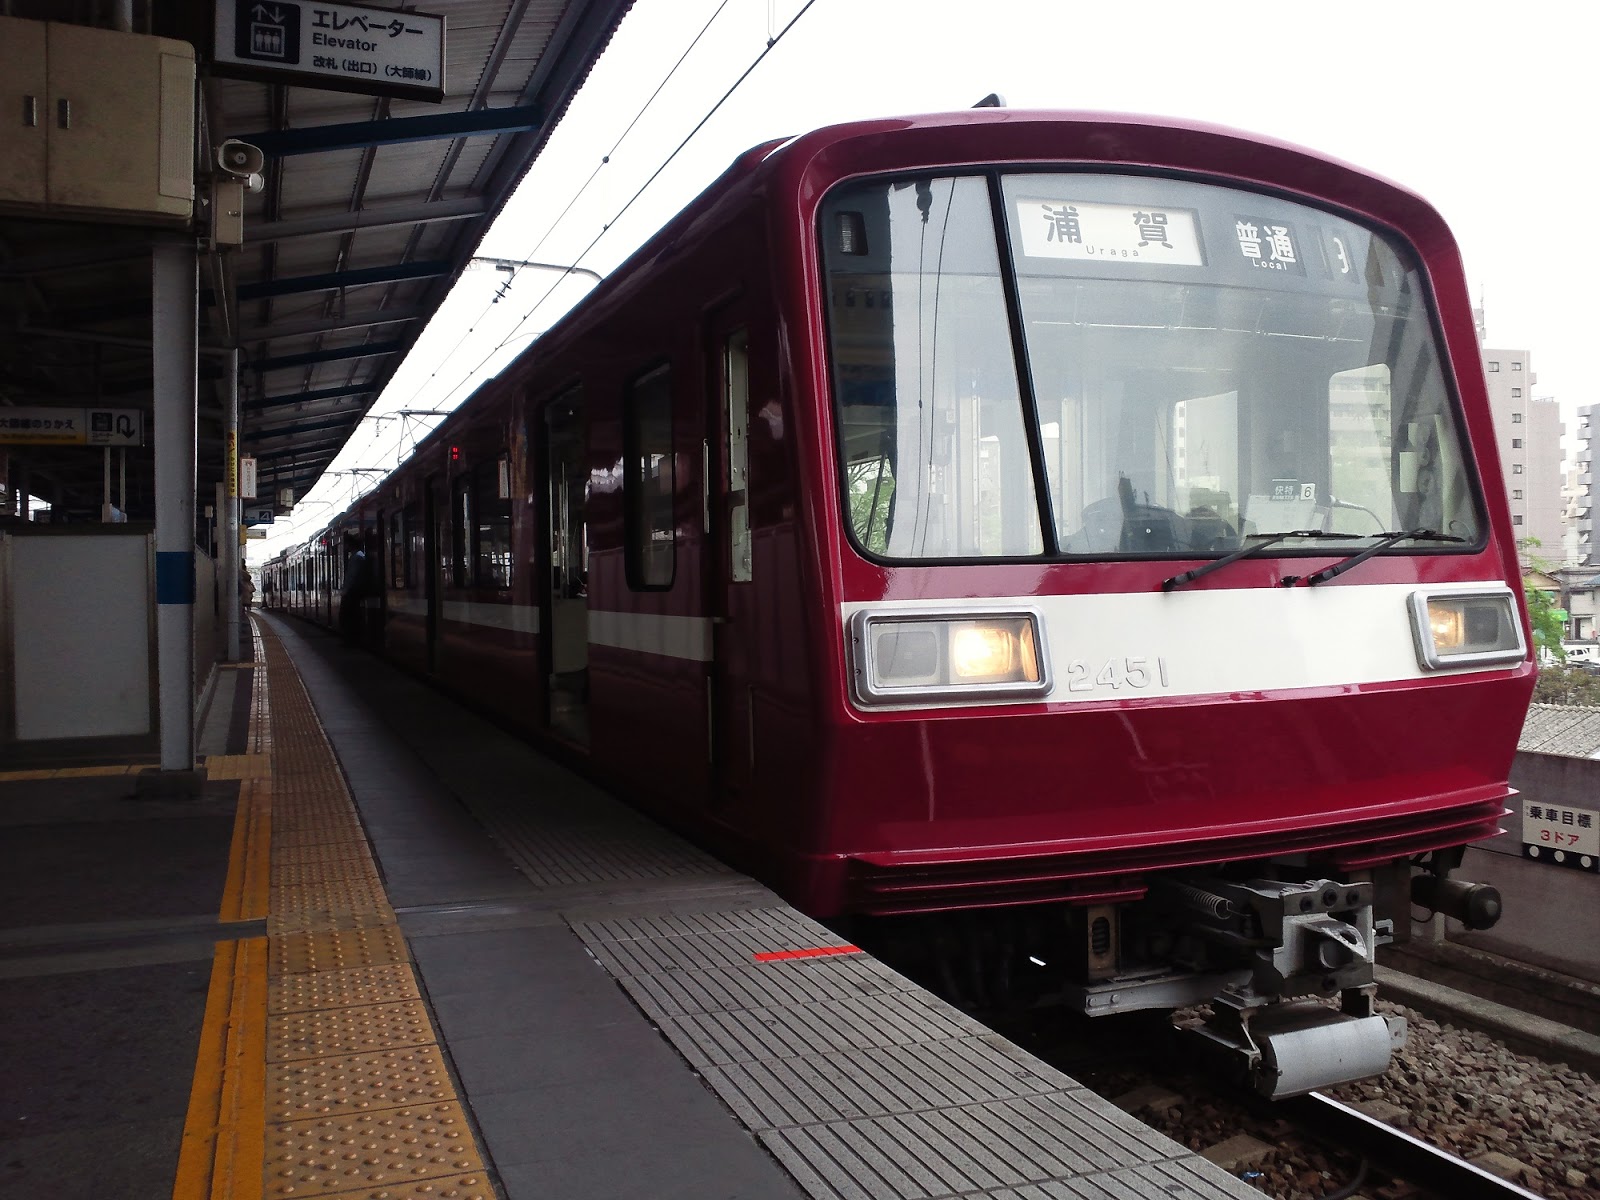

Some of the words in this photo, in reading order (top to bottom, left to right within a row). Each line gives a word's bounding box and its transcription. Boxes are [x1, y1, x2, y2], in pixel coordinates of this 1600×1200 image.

[312, 10, 423, 38] エレベーター
[312, 32, 378, 52] Elevator
[1235, 220, 1296, 263] 普通
[1085, 244, 1139, 258] Uraga
[1252, 257, 1287, 270] Local
[1304, 486, 1311, 498] 6
[260, 512, 270, 522] 4
[1068, 656, 1169, 692] 2451
[1529, 805, 1592, 829] 乗車目標
[1540, 829, 1580, 846] 3ドア
